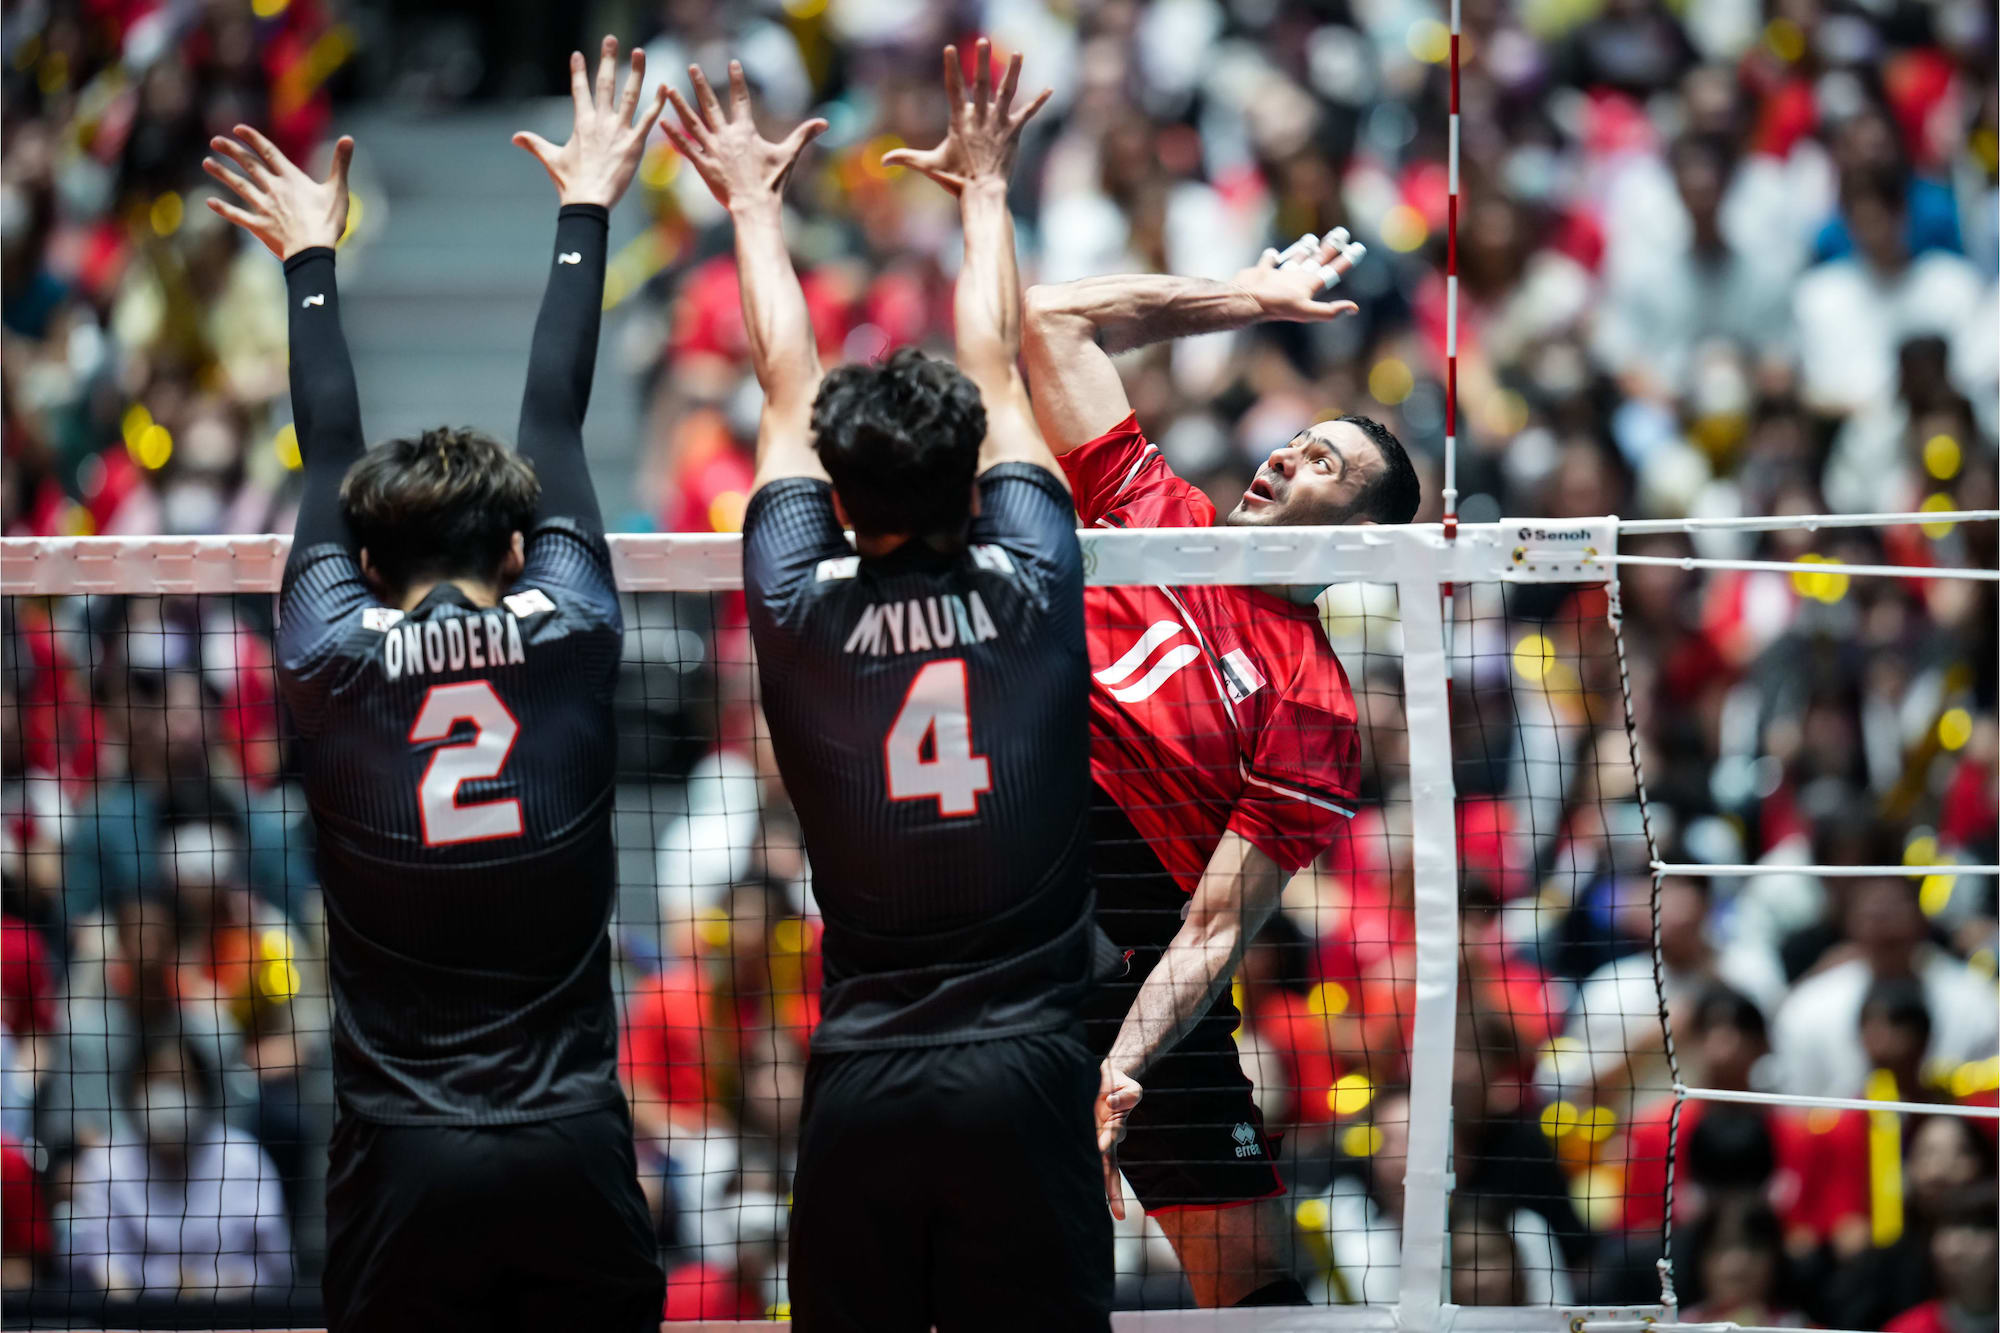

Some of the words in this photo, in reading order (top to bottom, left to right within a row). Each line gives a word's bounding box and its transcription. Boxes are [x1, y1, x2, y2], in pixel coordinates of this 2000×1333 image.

[1535, 529, 1591, 540] Senoh
[385, 613, 526, 682] ONODERA
[408, 679, 524, 846] 2
[884, 658, 993, 818] 4
